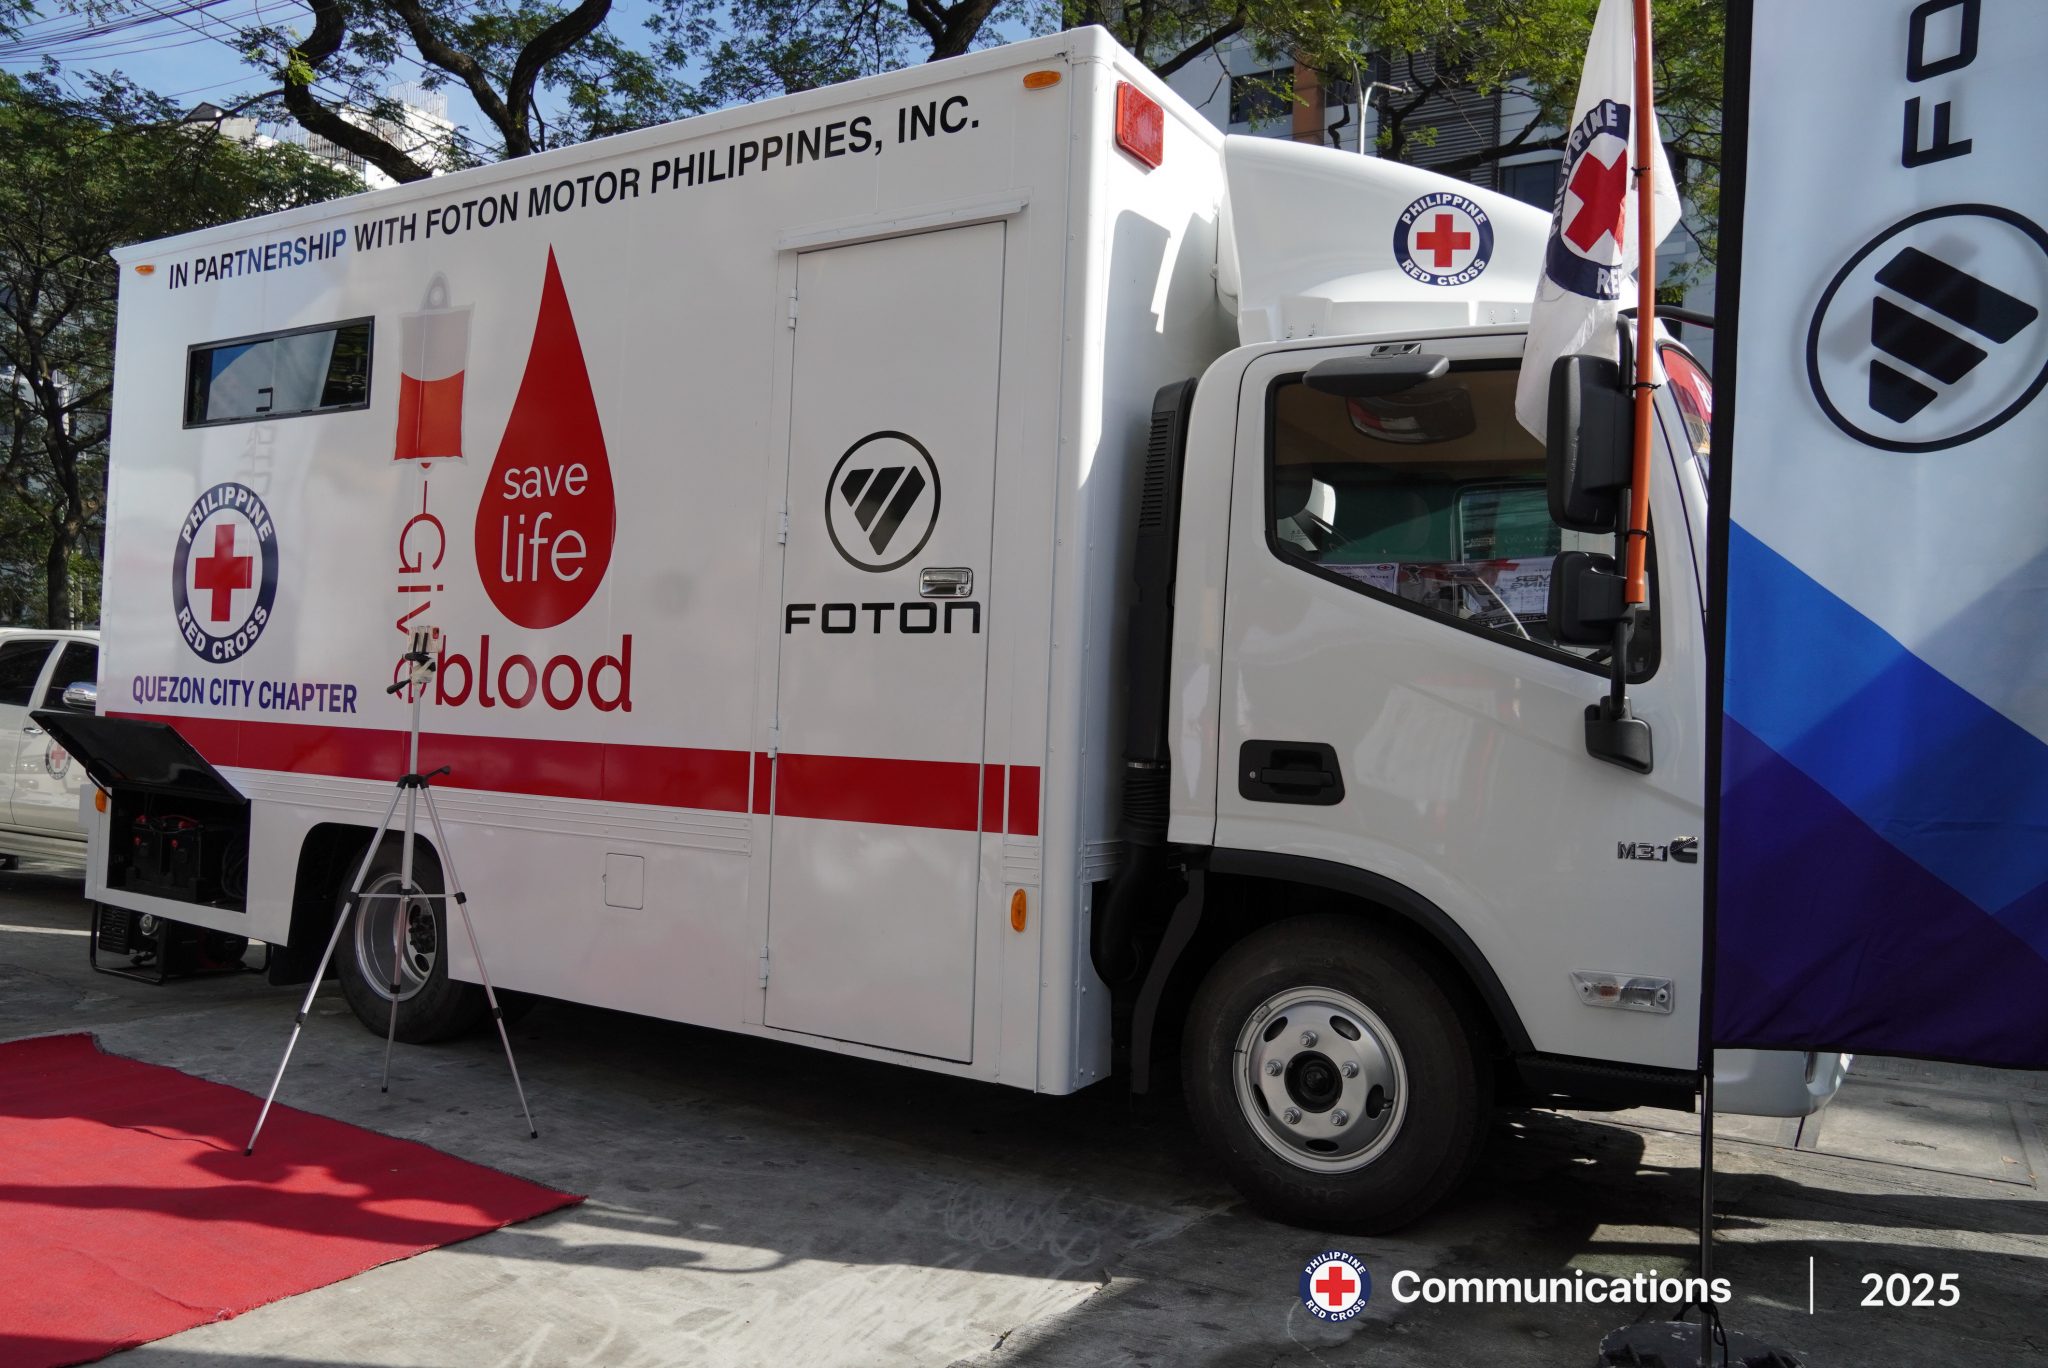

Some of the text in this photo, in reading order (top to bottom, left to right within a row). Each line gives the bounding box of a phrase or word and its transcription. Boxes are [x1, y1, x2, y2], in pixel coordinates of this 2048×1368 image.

[169, 94, 980, 290] IN PARTNERSHIP WITH FOTON MOTOR PHILIPPINES, INC.
[1400, 193, 1487, 226] PHILIPPINE
[1401, 258, 1486, 286] RED CROSS
[502, 462, 588, 500] save
[181, 486, 273, 544] PHILIPPINE
[501, 511, 587, 583] life
[178, 605, 267, 660] RED CROSS
[785, 601, 981, 634] FOTON
[132, 675, 357, 714] QUEZON CITY CHAPTER
[435, 634, 633, 713] blood
